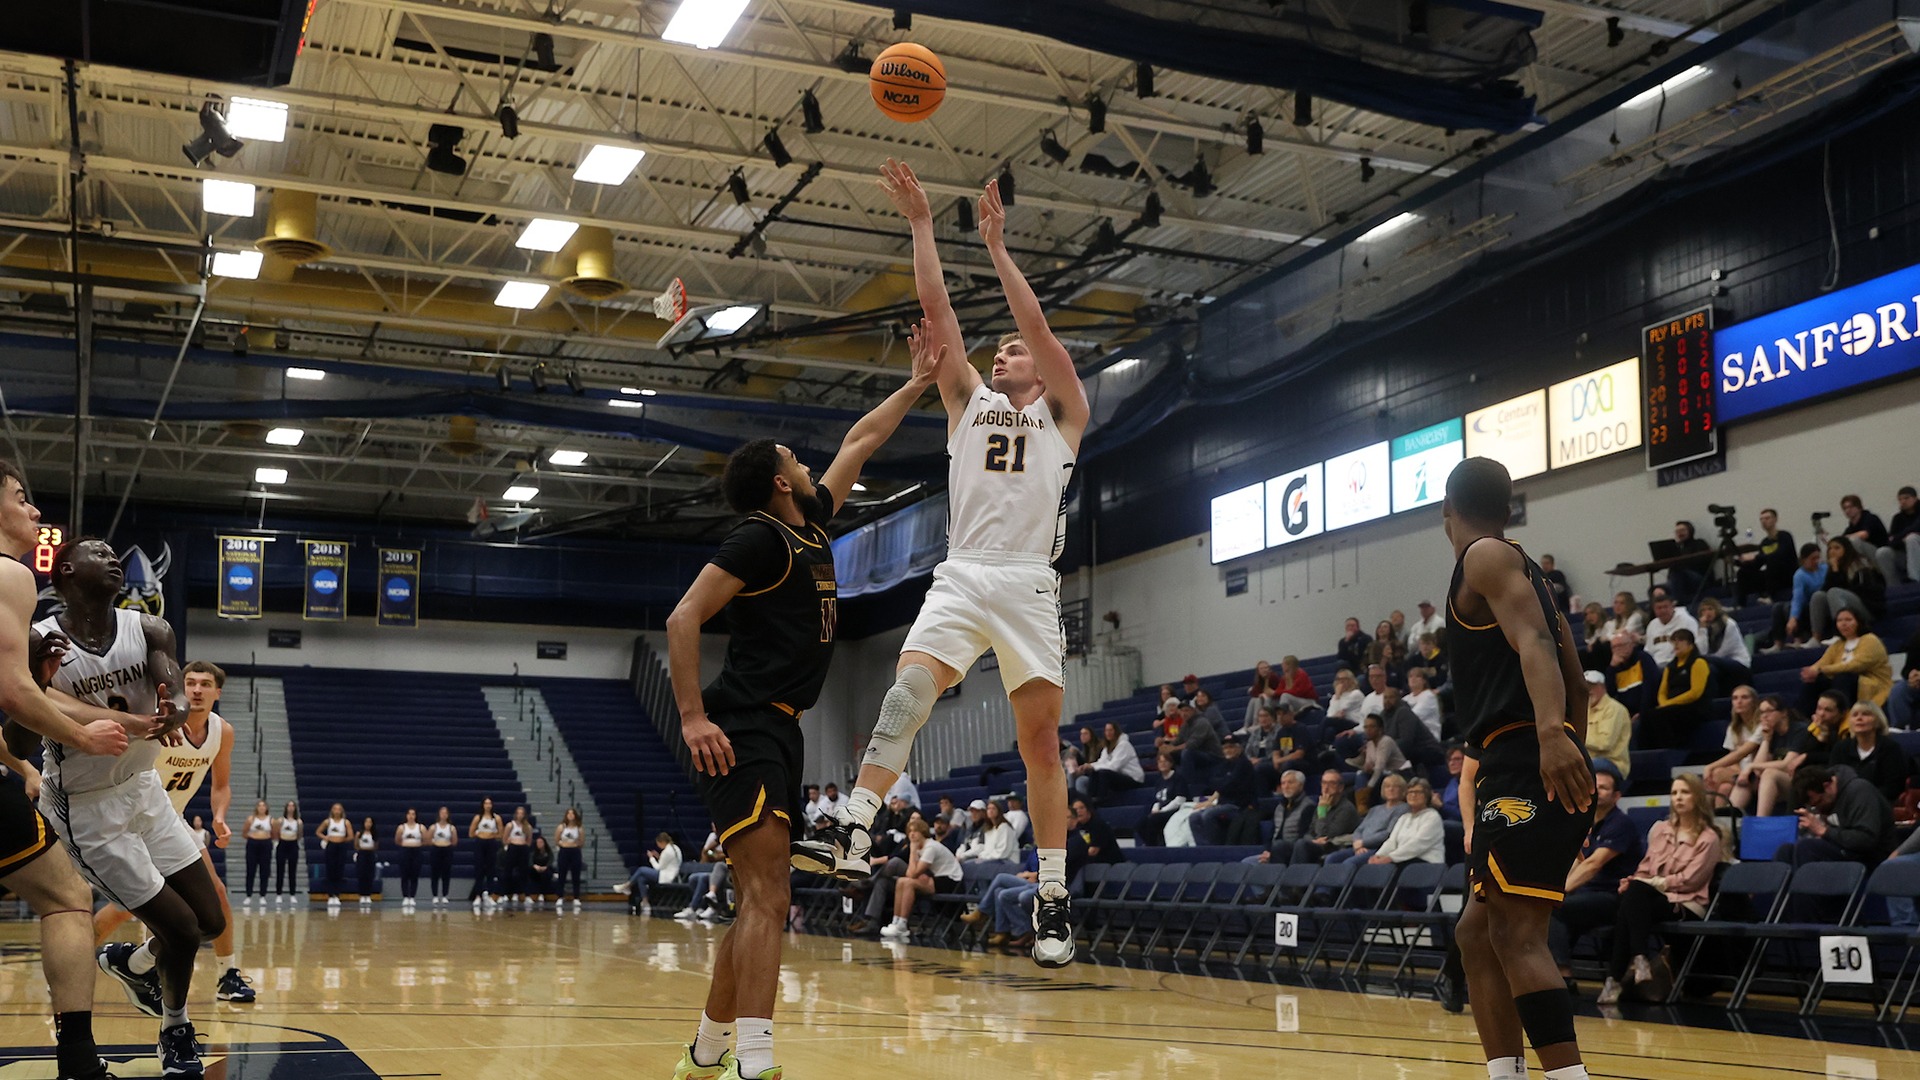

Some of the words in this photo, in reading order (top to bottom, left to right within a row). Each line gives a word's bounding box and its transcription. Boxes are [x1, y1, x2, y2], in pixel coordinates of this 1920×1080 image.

[881, 62, 930, 83] Wilson
[883, 90, 919, 105] NCAA
[1671, 320, 1684, 337] FL
[1685, 312, 1705, 333] PTS
[1677, 337, 1687, 355] 0
[1722, 294, 1920, 394] SANFOR
[1677, 357, 1687, 375] 0
[1678, 378, 1688, 396] 0
[1679, 397, 1689, 416] 0
[1651, 424, 1668, 445] 23
[1702, 412, 1711, 431] 3
[1560, 422, 1628, 463] MIDCO
[984, 432, 1026, 473] 21
[1663, 460, 1721, 482] VIKINGS
[38, 527, 62, 546] 23
[226, 539, 257, 551] 2016
[312, 543, 342, 555] 2018
[385, 551, 413, 563] 2019
[229, 576, 254, 586] NCAA
[314, 580, 338, 589] NCAA
[387, 588, 410, 597] NCAA
[165, 771, 195, 792] 20
[1279, 921, 1293, 938] 20
[1830, 946, 1862, 971] 10
